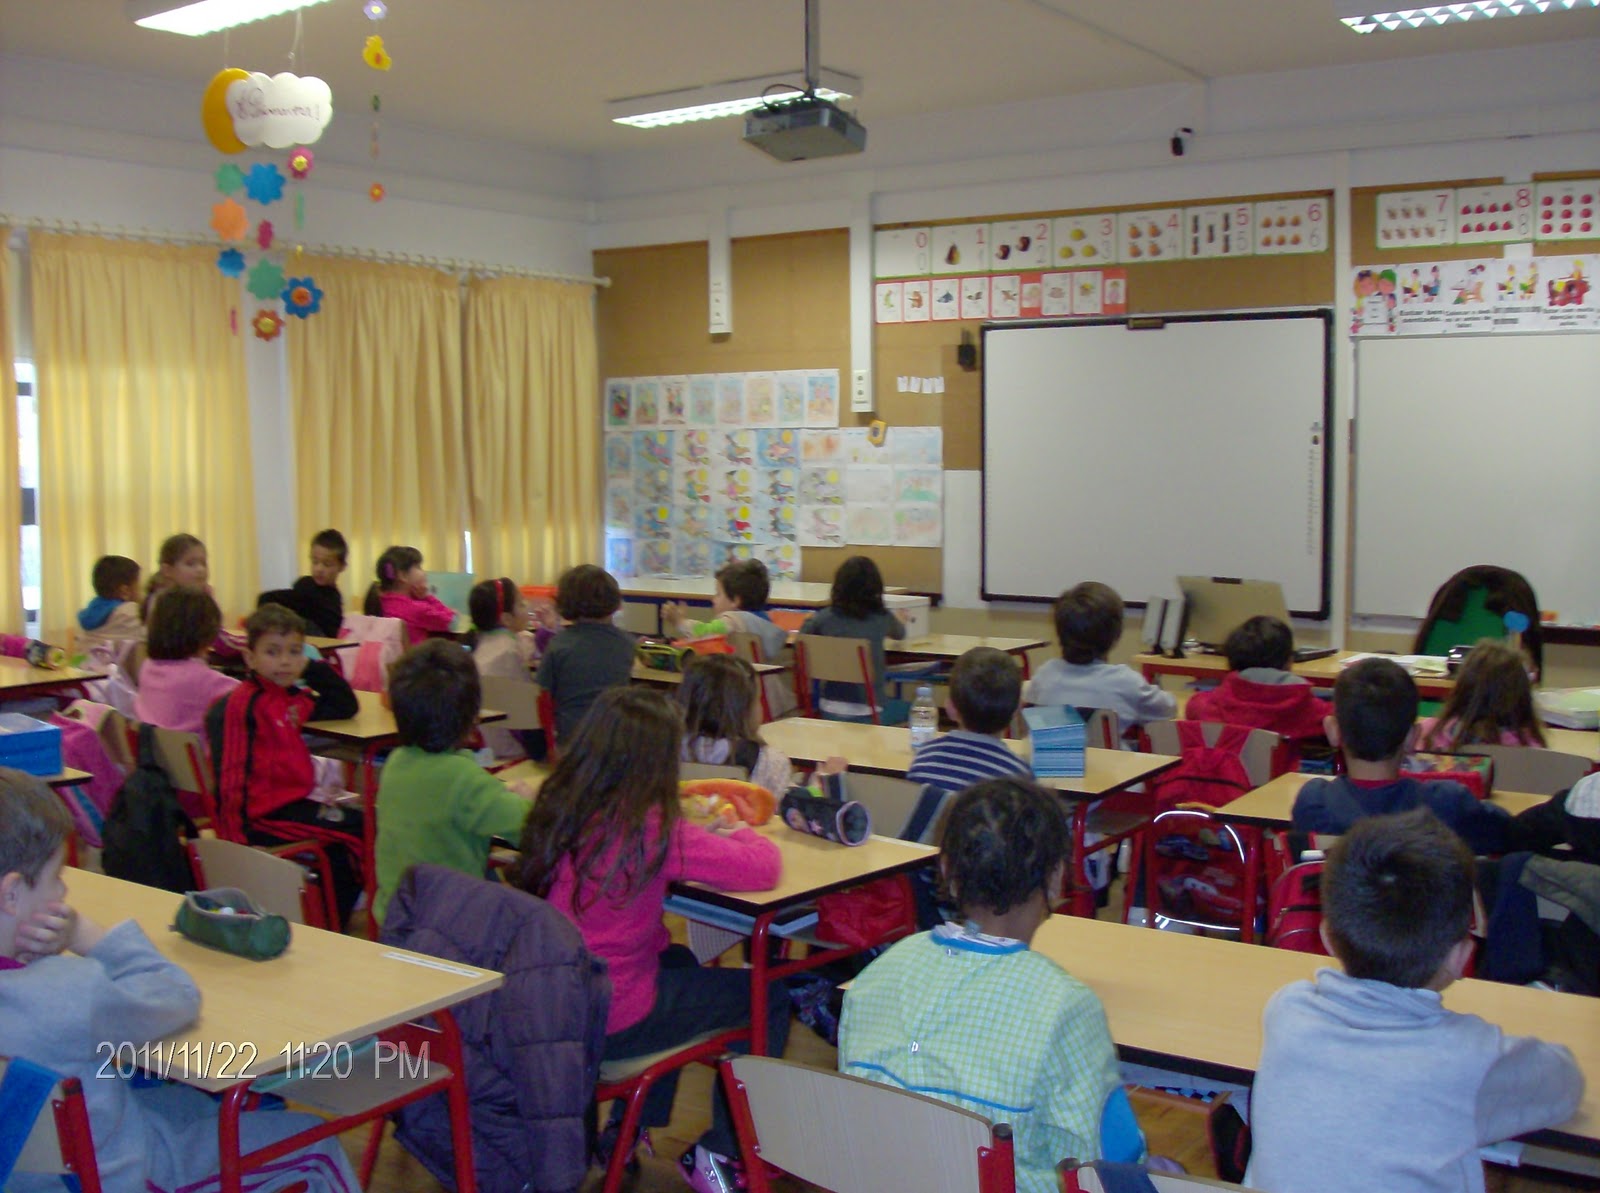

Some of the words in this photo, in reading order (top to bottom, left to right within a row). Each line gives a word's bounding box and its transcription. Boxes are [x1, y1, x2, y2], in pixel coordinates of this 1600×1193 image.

[1435, 194, 1448, 213] 7
[1516, 188, 1531, 208] 8
[1167, 213, 1179, 229] 4
[1236, 208, 1249, 226] 5
[1307, 203, 1322, 222] 6
[976, 228, 985, 244] 1
[1036, 223, 1047, 240] 2
[1100, 218, 1112, 236] 3
[916, 231, 928, 249] 0
[1236, 230, 1248, 251] 5
[1309, 228, 1320, 248] 6
